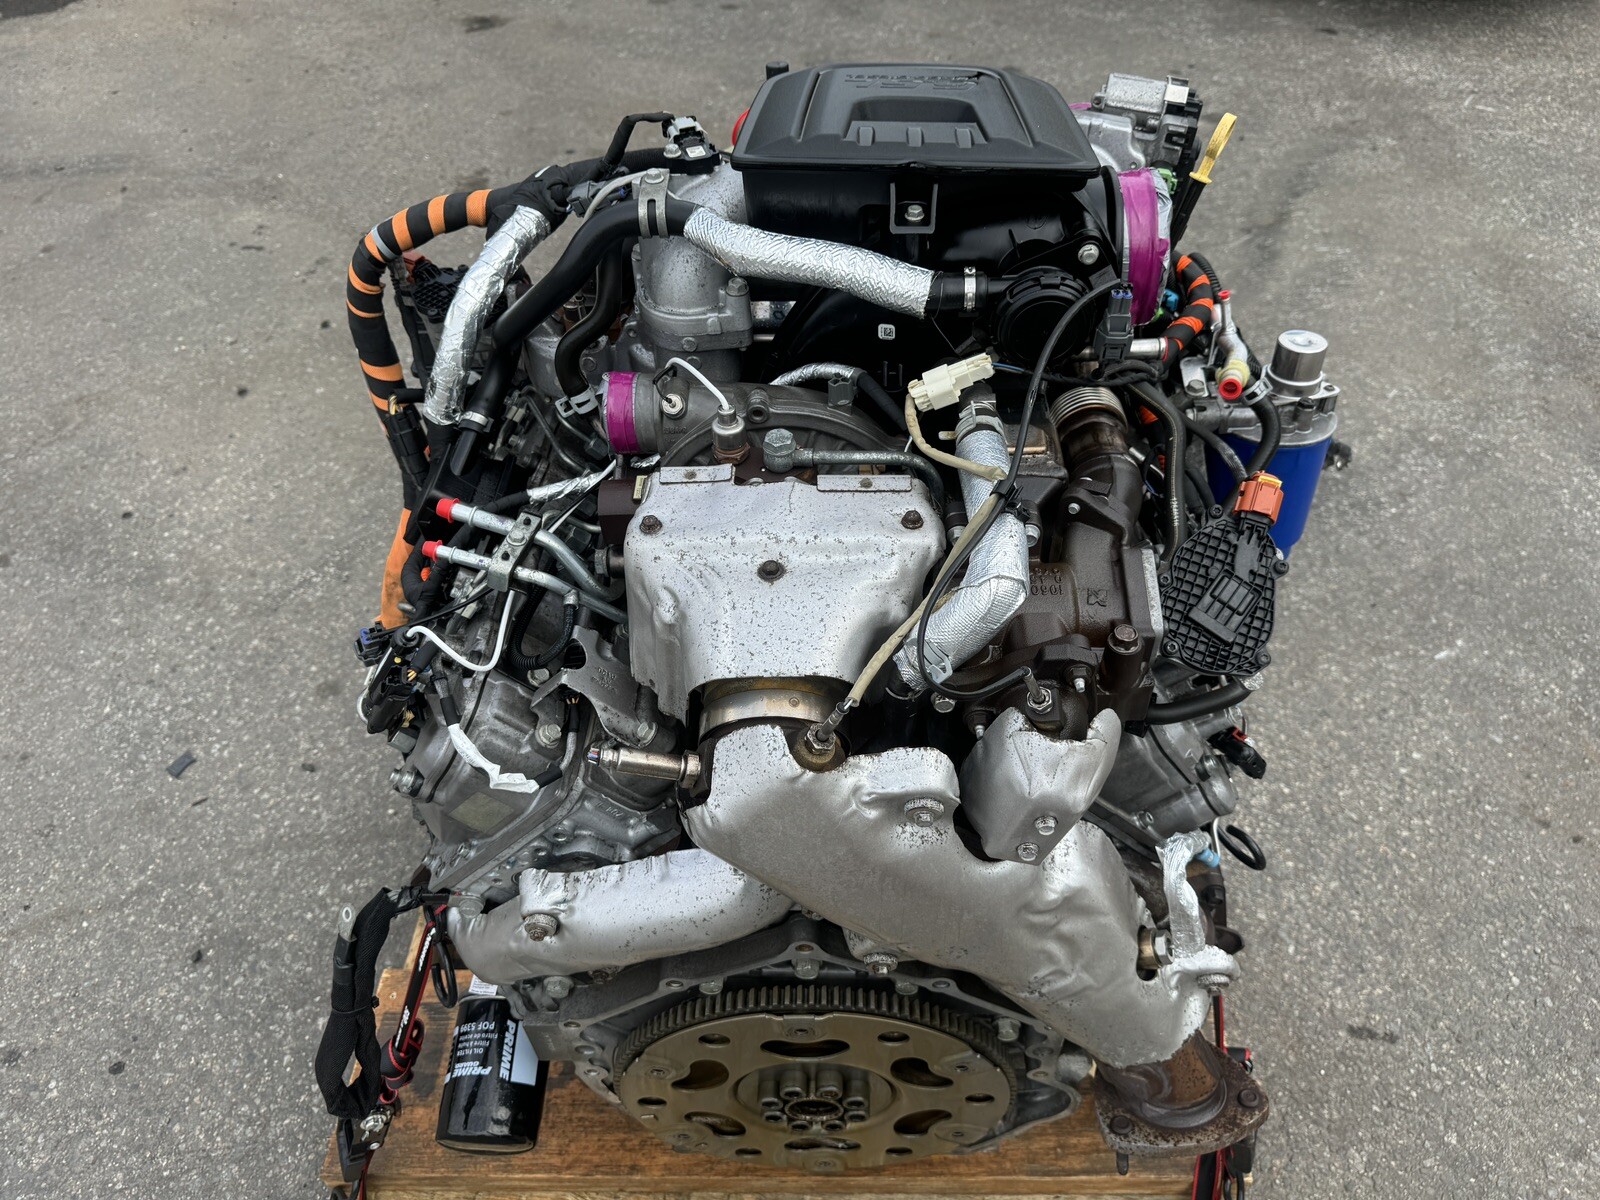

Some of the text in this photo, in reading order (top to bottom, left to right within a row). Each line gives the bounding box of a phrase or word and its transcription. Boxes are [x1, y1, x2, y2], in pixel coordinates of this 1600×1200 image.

[478, 1021, 495, 1030] POF
[499, 1019, 516, 1082] PRIME
[455, 1061, 479, 1069] GUARD
[451, 1066, 492, 1078] PRIME
